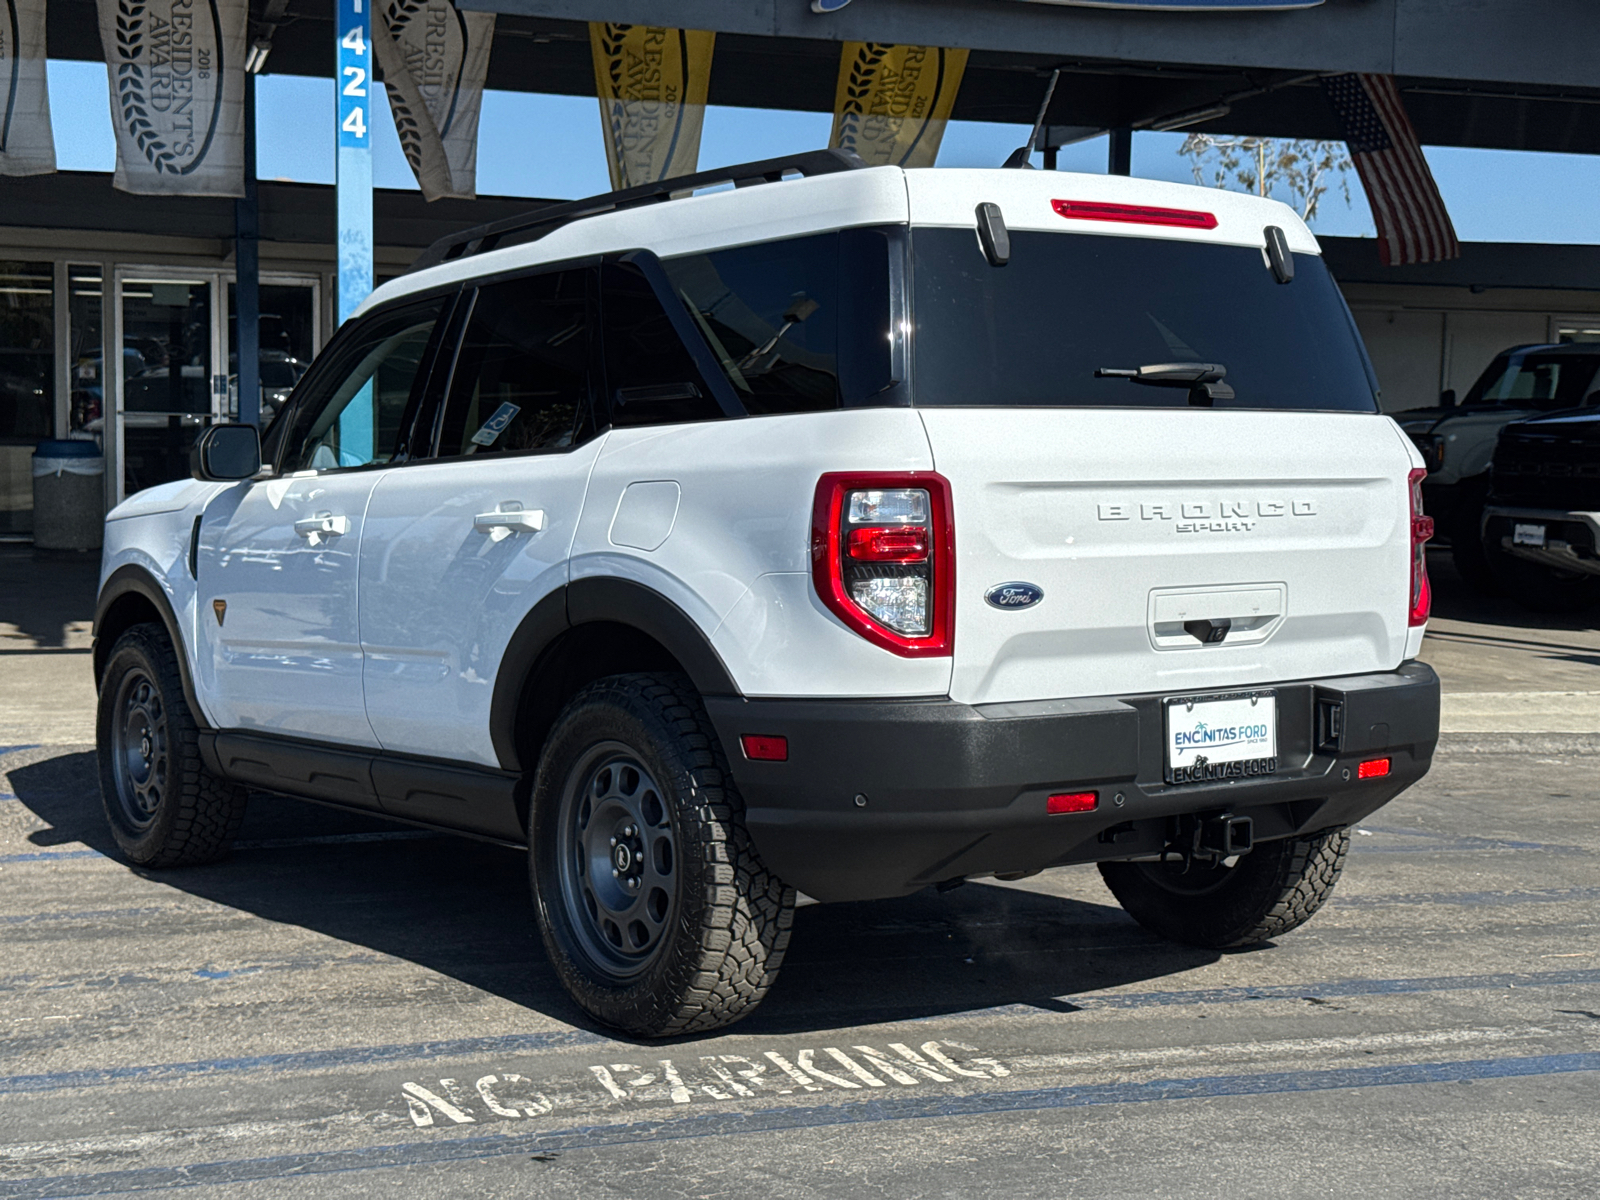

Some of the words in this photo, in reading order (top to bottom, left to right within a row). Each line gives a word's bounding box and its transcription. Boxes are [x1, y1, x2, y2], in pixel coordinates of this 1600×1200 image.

[149, 12, 171, 112] AWARD
[198, 49, 210, 79] 2018
[424, 5, 448, 108] PRESIDE
[622, 50, 644, 150] AWARD
[634, 27, 667, 187] RESIDENT'
[665, 85, 677, 118] 2020
[862, 65, 899, 141] AWARD
[911, 96, 928, 118] 2021
[1097, 501, 1318, 521] BRONCO
[1176, 521, 1257, 533] SPORT
[999, 588, 1032, 605] Ford
[1175, 726, 1237, 745] ENCINITAS
[1239, 724, 1268, 740] FORD
[1173, 761, 1242, 782] ENCINITAS
[1244, 758, 1276, 774] FORD
[401, 1074, 553, 1127] NO
[588, 1040, 1011, 1104] PARKING
